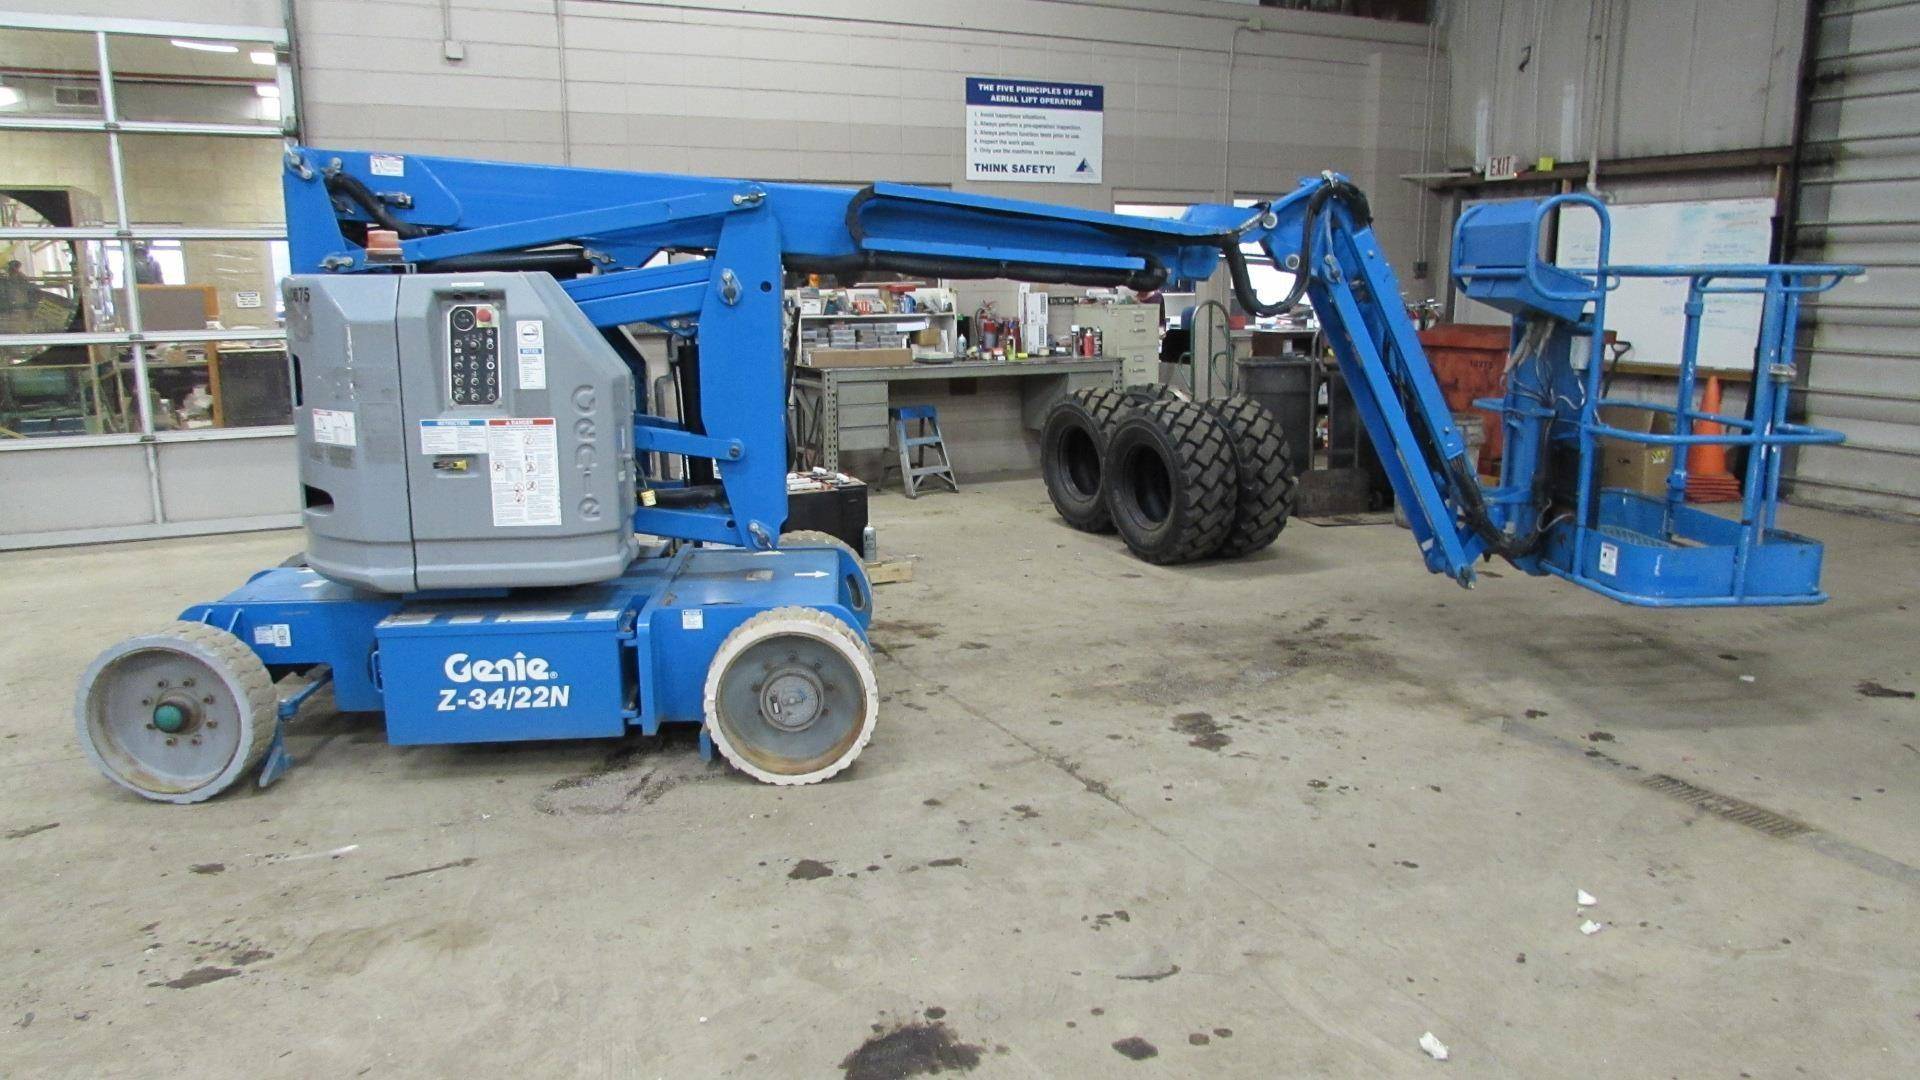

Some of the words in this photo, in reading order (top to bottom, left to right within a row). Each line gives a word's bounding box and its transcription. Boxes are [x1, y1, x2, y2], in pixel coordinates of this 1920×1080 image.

[978, 83, 994, 92] THE
[996, 84, 1016, 93] FIVE
[1016, 85, 1061, 95] PRINCIPLES
[1063, 88, 1073, 96] OF
[1074, 89, 1094, 97] SAFE
[990, 94, 1019, 103] AERIAL
[1021, 96, 1038, 104] LIFT
[1040, 97, 1082, 106] OPERATION
[974, 163, 1009, 173] THINK
[1011, 164, 1056, 174] SAFETY!
[1490, 156, 1511, 177] EXIT
[437, 686, 570, 711] Z-34/22N
